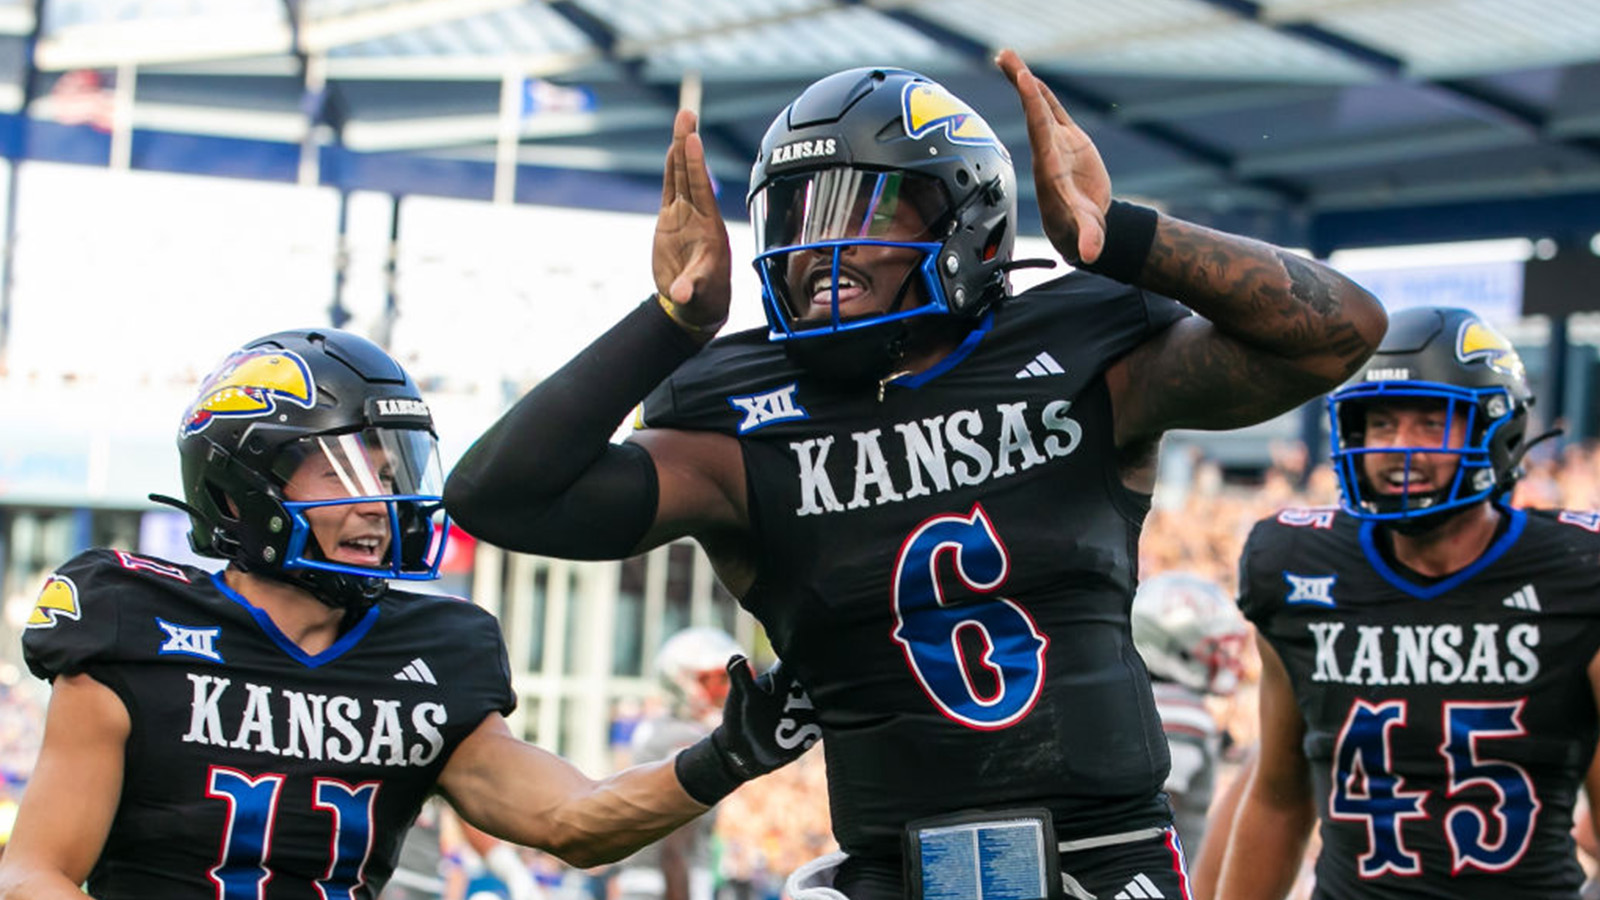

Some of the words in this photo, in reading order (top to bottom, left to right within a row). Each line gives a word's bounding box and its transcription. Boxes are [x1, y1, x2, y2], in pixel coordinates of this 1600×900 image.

[771, 138, 836, 164] KANSAS
[789, 400, 1083, 517] KANSAS
[890, 502, 1050, 732] 6
[1308, 621, 1541, 685] KANSAS
[182, 673, 448, 767] KANSAS
[205, 764, 383, 900] 11
[1329, 697, 1542, 879] 45
